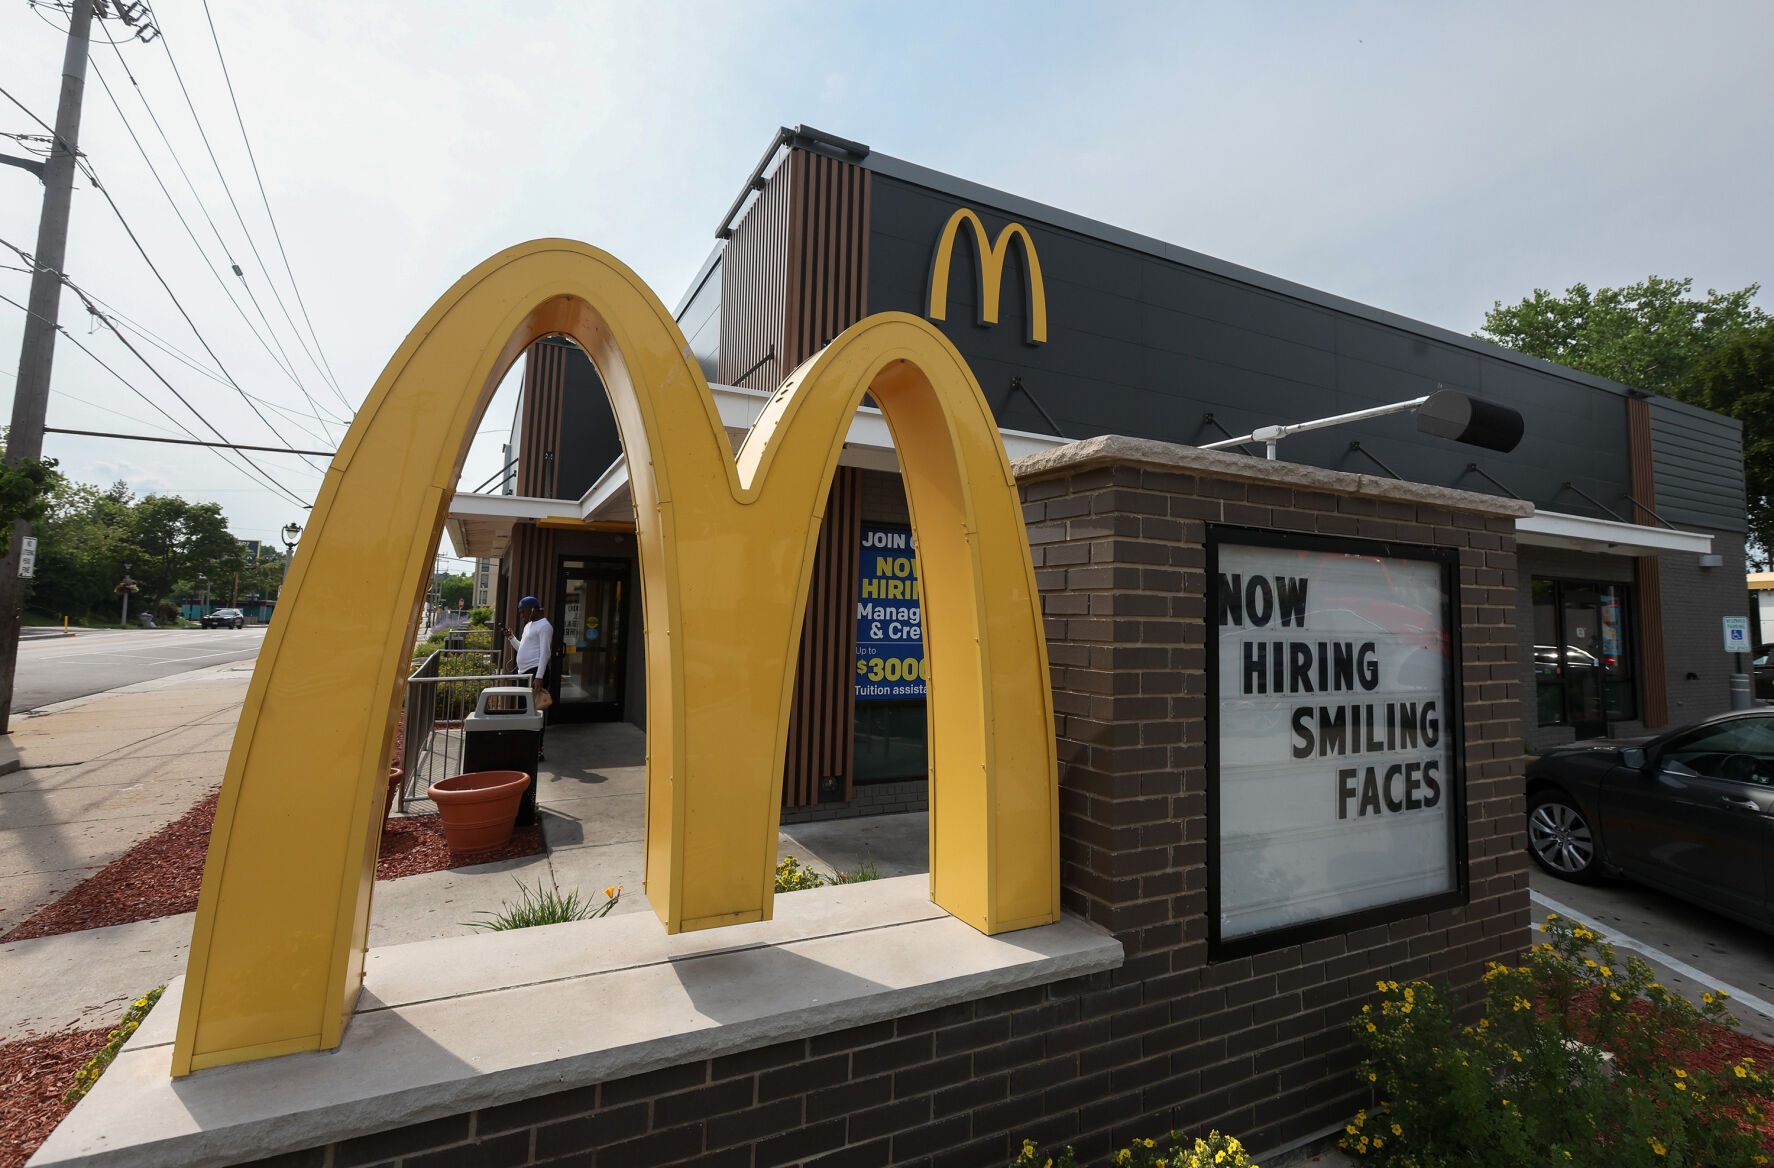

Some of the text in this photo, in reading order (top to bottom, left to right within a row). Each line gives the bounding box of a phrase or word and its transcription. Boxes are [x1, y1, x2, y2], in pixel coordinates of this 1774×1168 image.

[862, 532, 906, 549] JOIN
[1218, 572, 1308, 628] NOW
[870, 621, 922, 639] & Cre
[855, 646, 877, 656] Up to
[1243, 641, 1379, 695] HIRING
[854, 685, 890, 695] Tuition
[1291, 701, 1439, 759] SMILING
[1338, 760, 1441, 820] FACES
